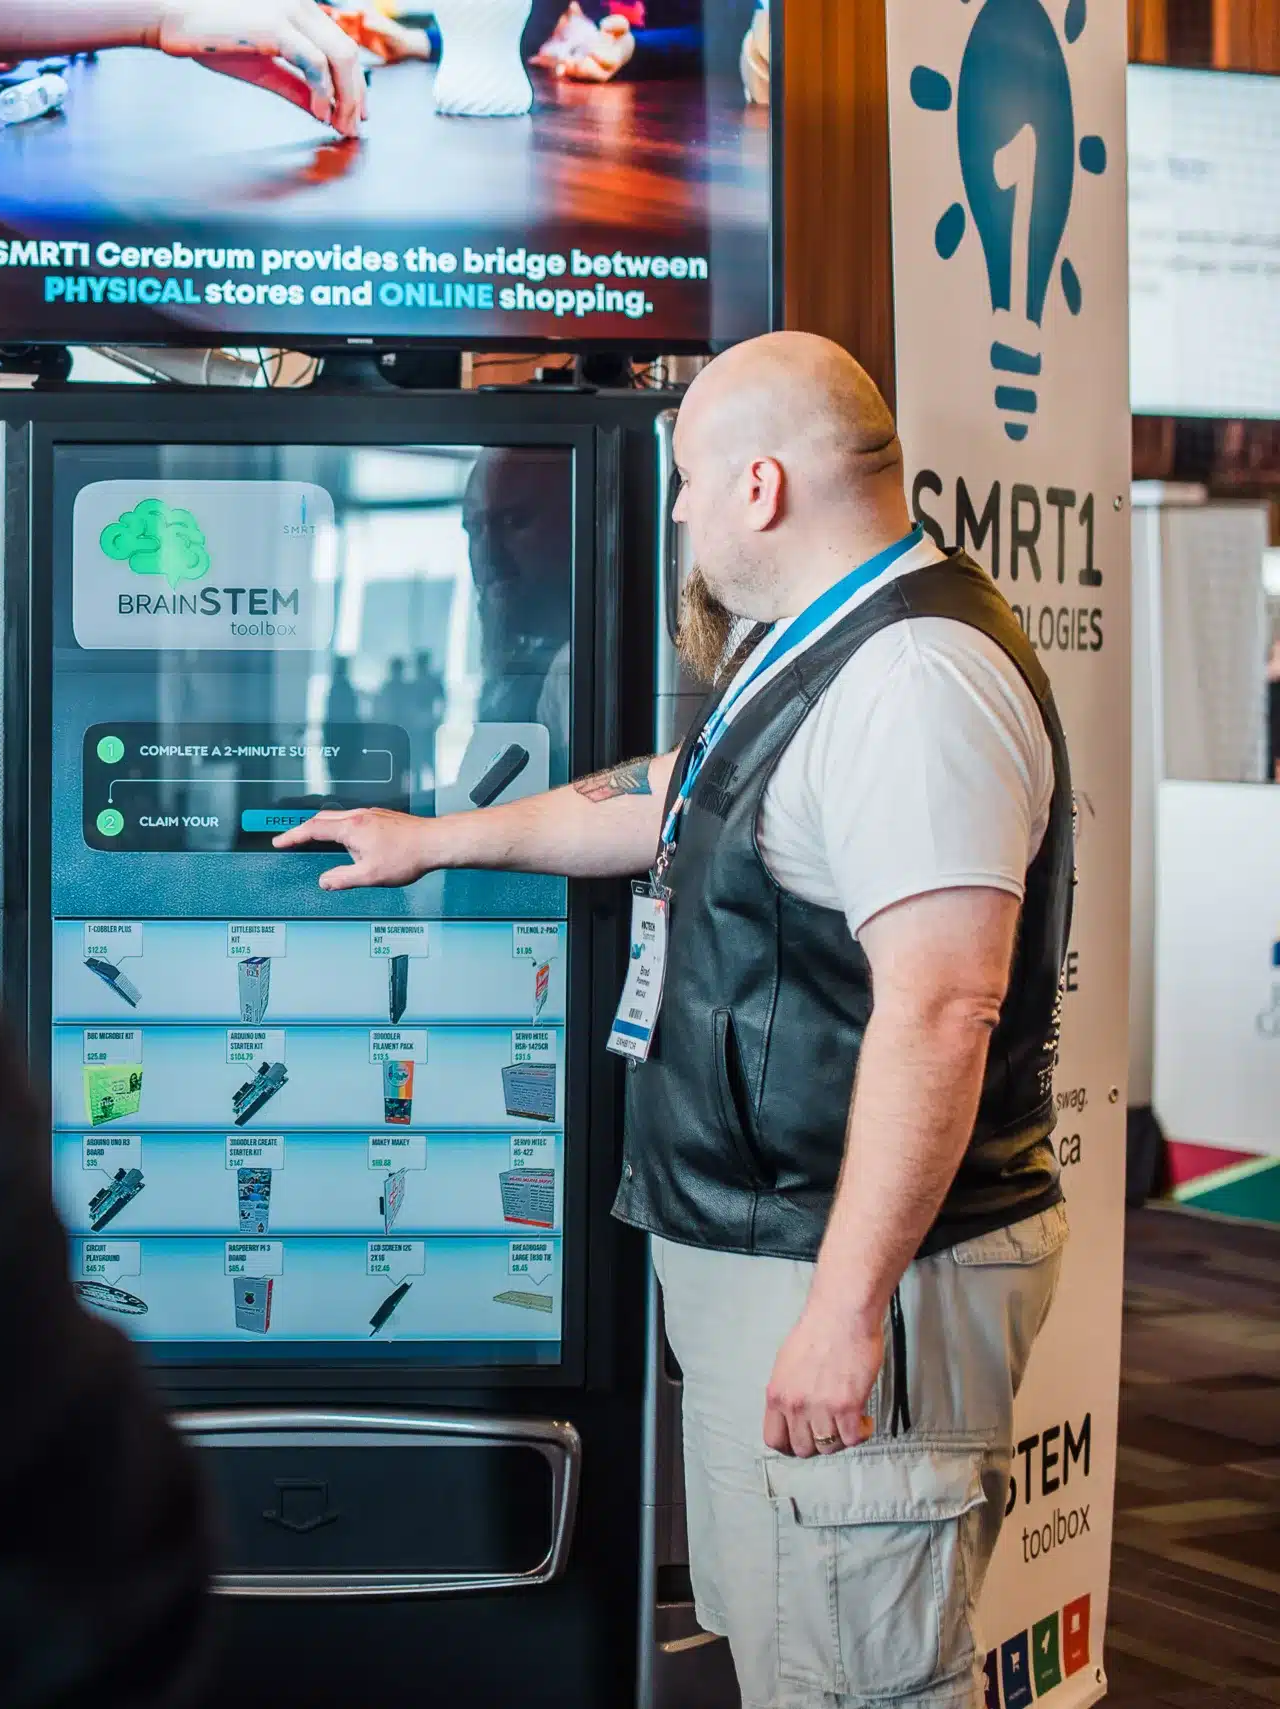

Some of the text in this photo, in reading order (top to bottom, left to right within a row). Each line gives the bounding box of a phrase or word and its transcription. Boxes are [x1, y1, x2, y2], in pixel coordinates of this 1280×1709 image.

[96, 242, 255, 269] Cerebrum
[261, 244, 399, 275] provides
[403, 247, 458, 273] the
[463, 247, 566, 282] bridge
[571, 249, 708, 279] between
[44, 276, 654, 318] PHYSICAL stores and ONLINE shopping.
[283, 524, 316, 534] SMRT
[912, 469, 1102, 586] SMRT1
[118, 587, 299, 615] BRAINSTEM
[230, 621, 297, 636] toolbox
[139, 746, 208, 756] COMPLETE
[211, 746, 221, 756] A
[224, 746, 287, 756] 2-MINUTE
[139, 816, 179, 827] CLAIM
[182, 816, 219, 827] YOUR
[265, 816, 296, 825] FREE
[117, 925, 132, 933] PLUS
[261, 926, 275, 934] BASE
[387, 926, 424, 934] SCREWDRIVER
[258, 1138, 277, 1146] CREATE
[229, 1148, 263, 1156] STARTER KIT
[1059, 1133, 1081, 1167] ca
[86, 1244, 106, 1252] CIRCUIT
[228, 1244, 259, 1252] RASPBERRY
[1022, 1504, 1090, 1563] toolbox
